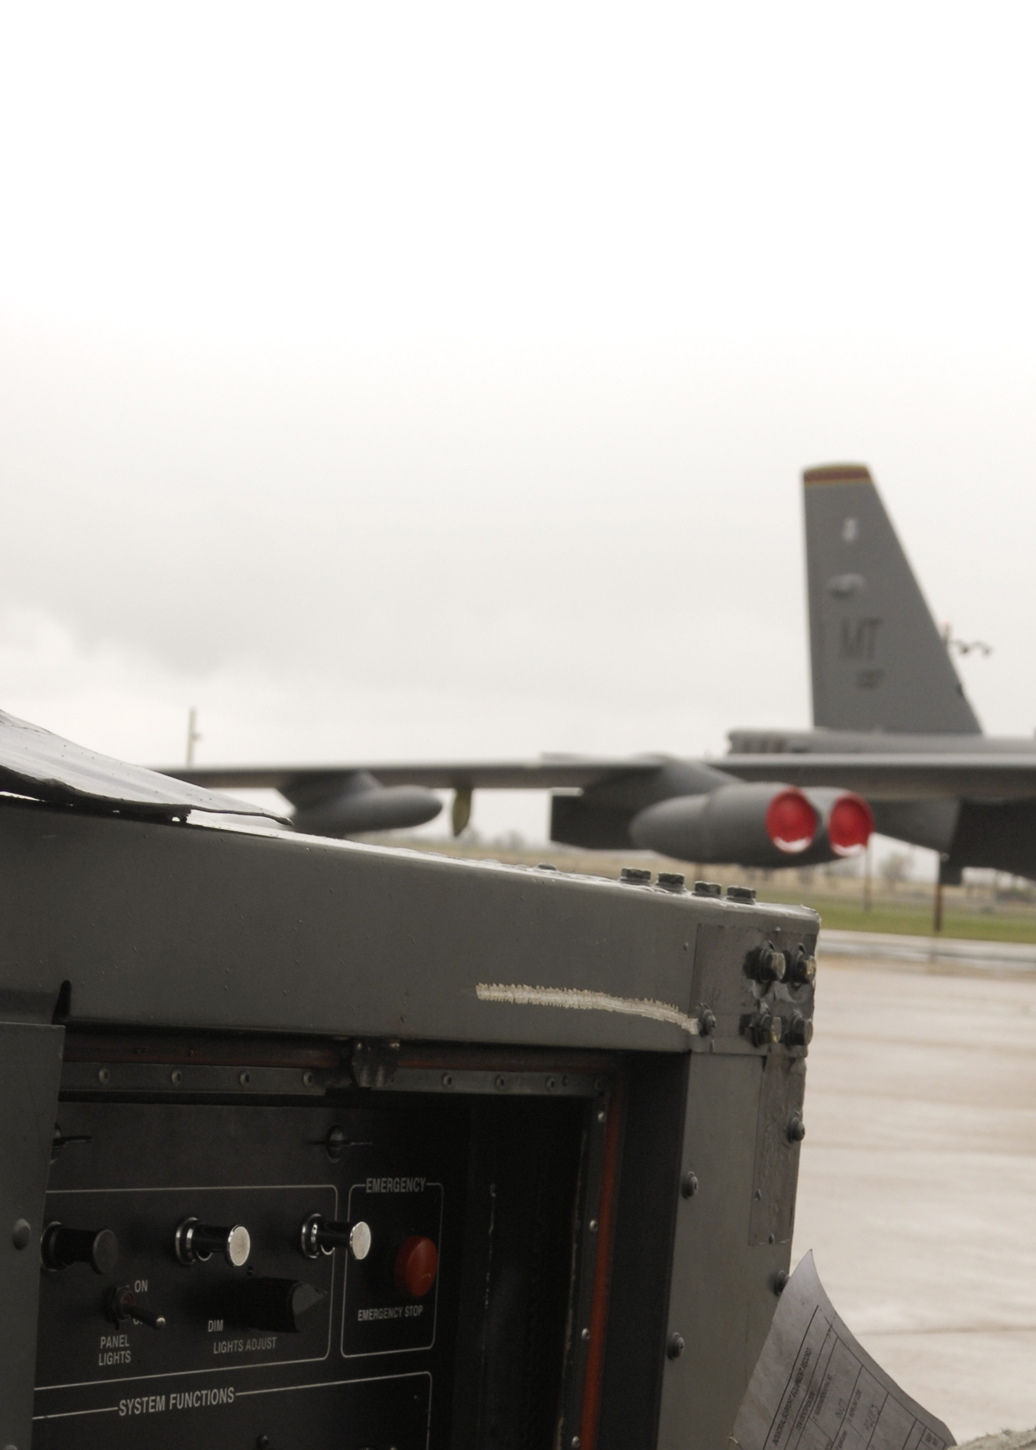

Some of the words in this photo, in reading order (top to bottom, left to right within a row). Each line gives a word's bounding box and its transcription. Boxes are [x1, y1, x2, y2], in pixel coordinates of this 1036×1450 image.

[366, 1177, 426, 1194] EMERGENCY
[134, 1280, 148, 1293] ON
[358, 1306, 404, 1322] EMERGENCY
[404, 1304, 424, 1318] STOP
[208, 1319, 224, 1332] DIM
[100, 1334, 130, 1349] PANEL
[213, 1339, 243, 1354] LIGHTS
[245, 1336, 277, 1351] ADJUST
[98, 1351, 132, 1366] LIGHTS
[118, 1394, 165, 1416] SYSTEM
[169, 1387, 235, 1410] FUNCTIONS
